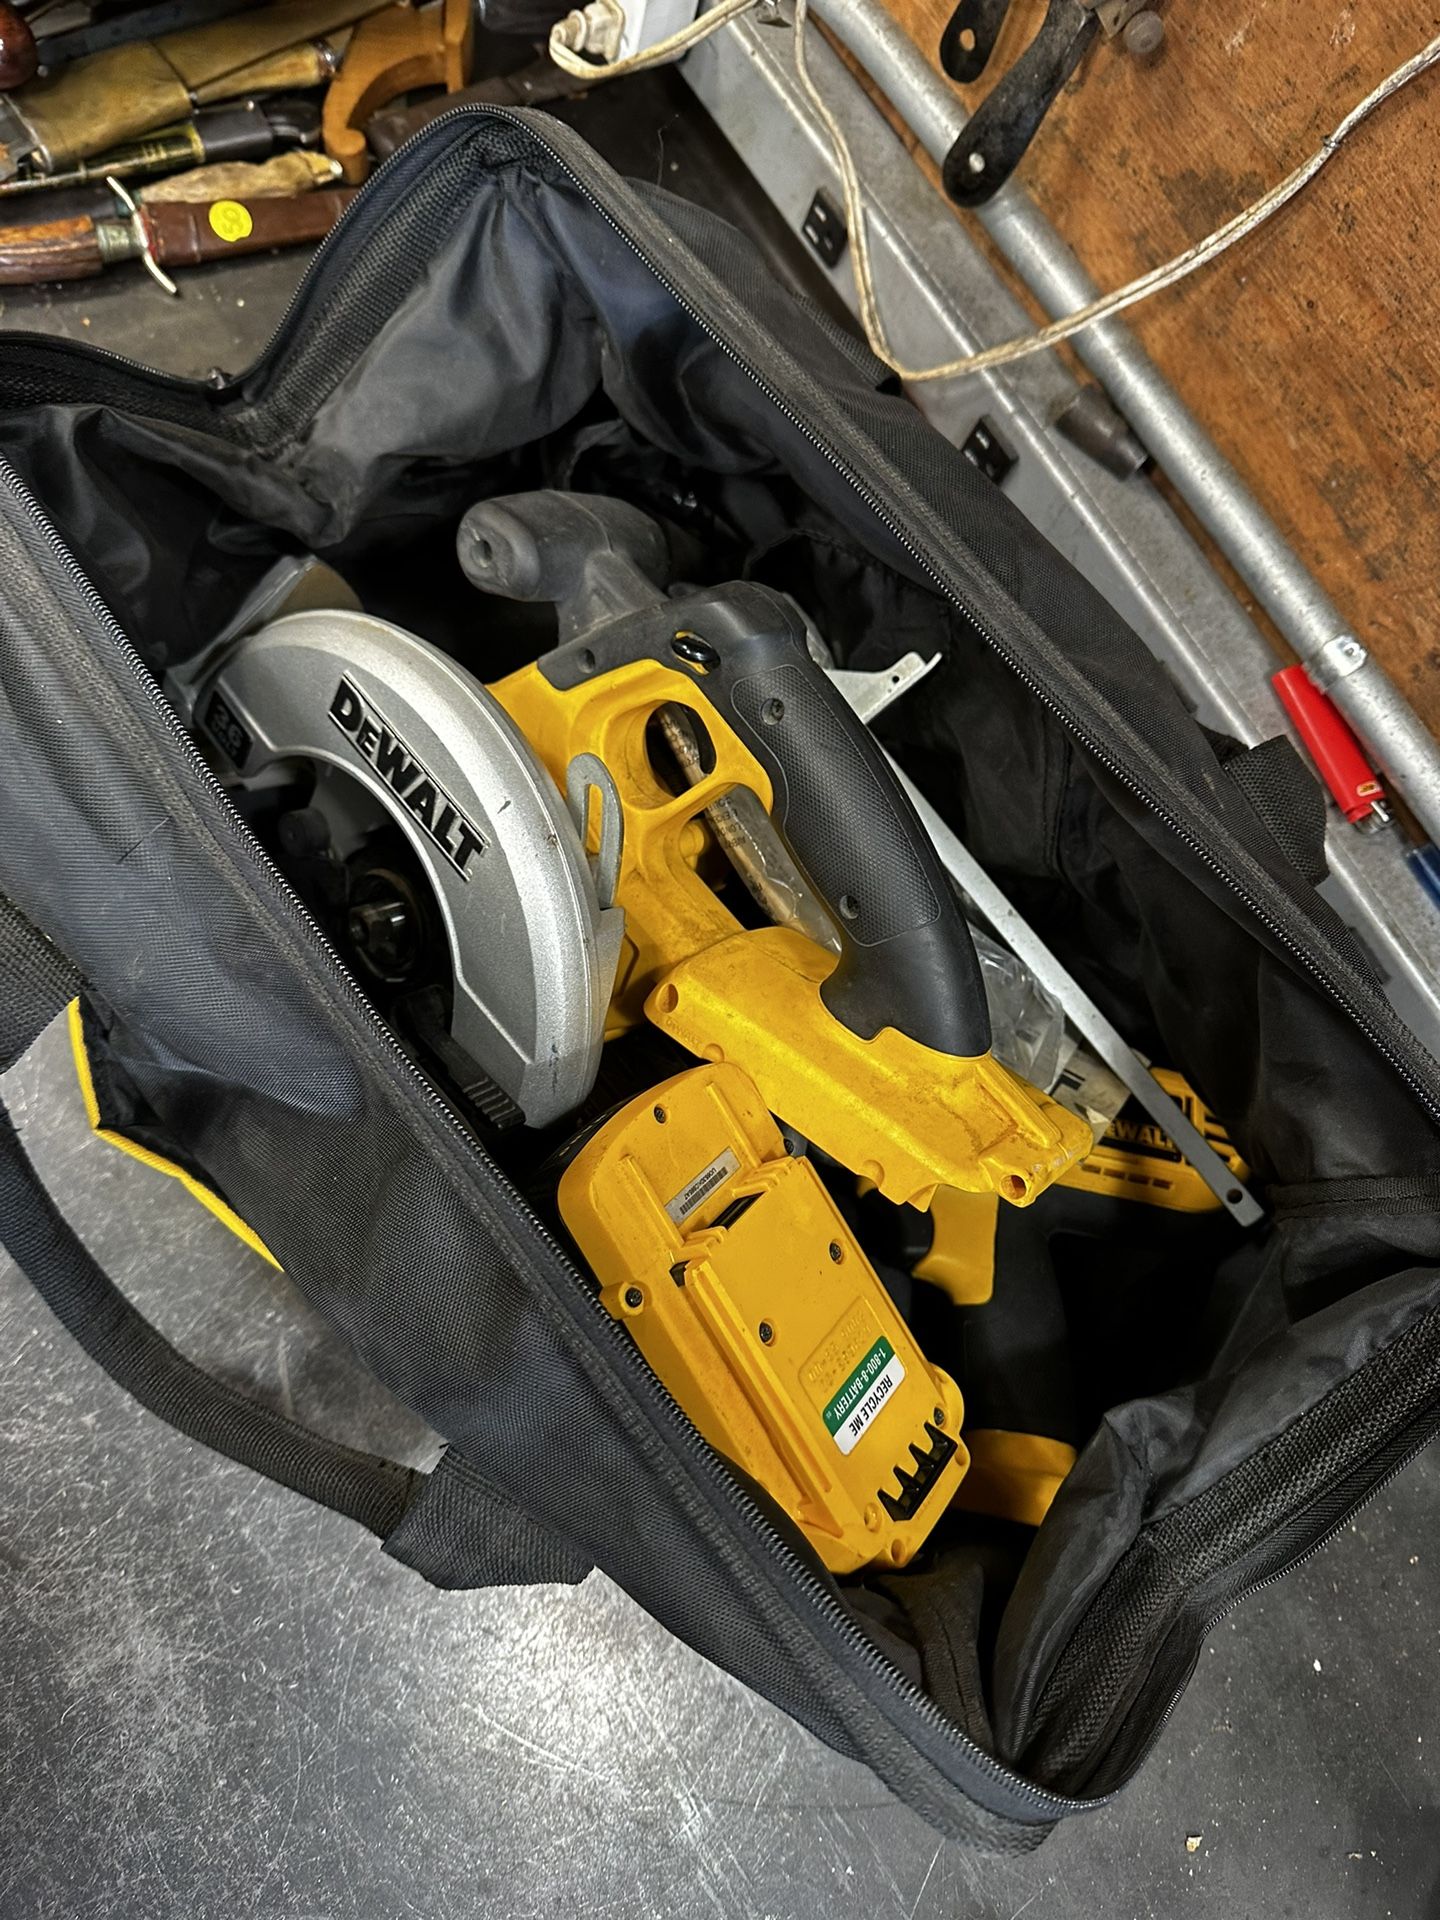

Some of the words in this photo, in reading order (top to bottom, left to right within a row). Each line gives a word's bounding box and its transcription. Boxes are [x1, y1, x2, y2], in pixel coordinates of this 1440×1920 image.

[835, 1348, 886, 1420] 1-800-8-BATTERY
[860, 1374, 893, 1417] RECYCLE
[849, 1415, 866, 1437] ME
